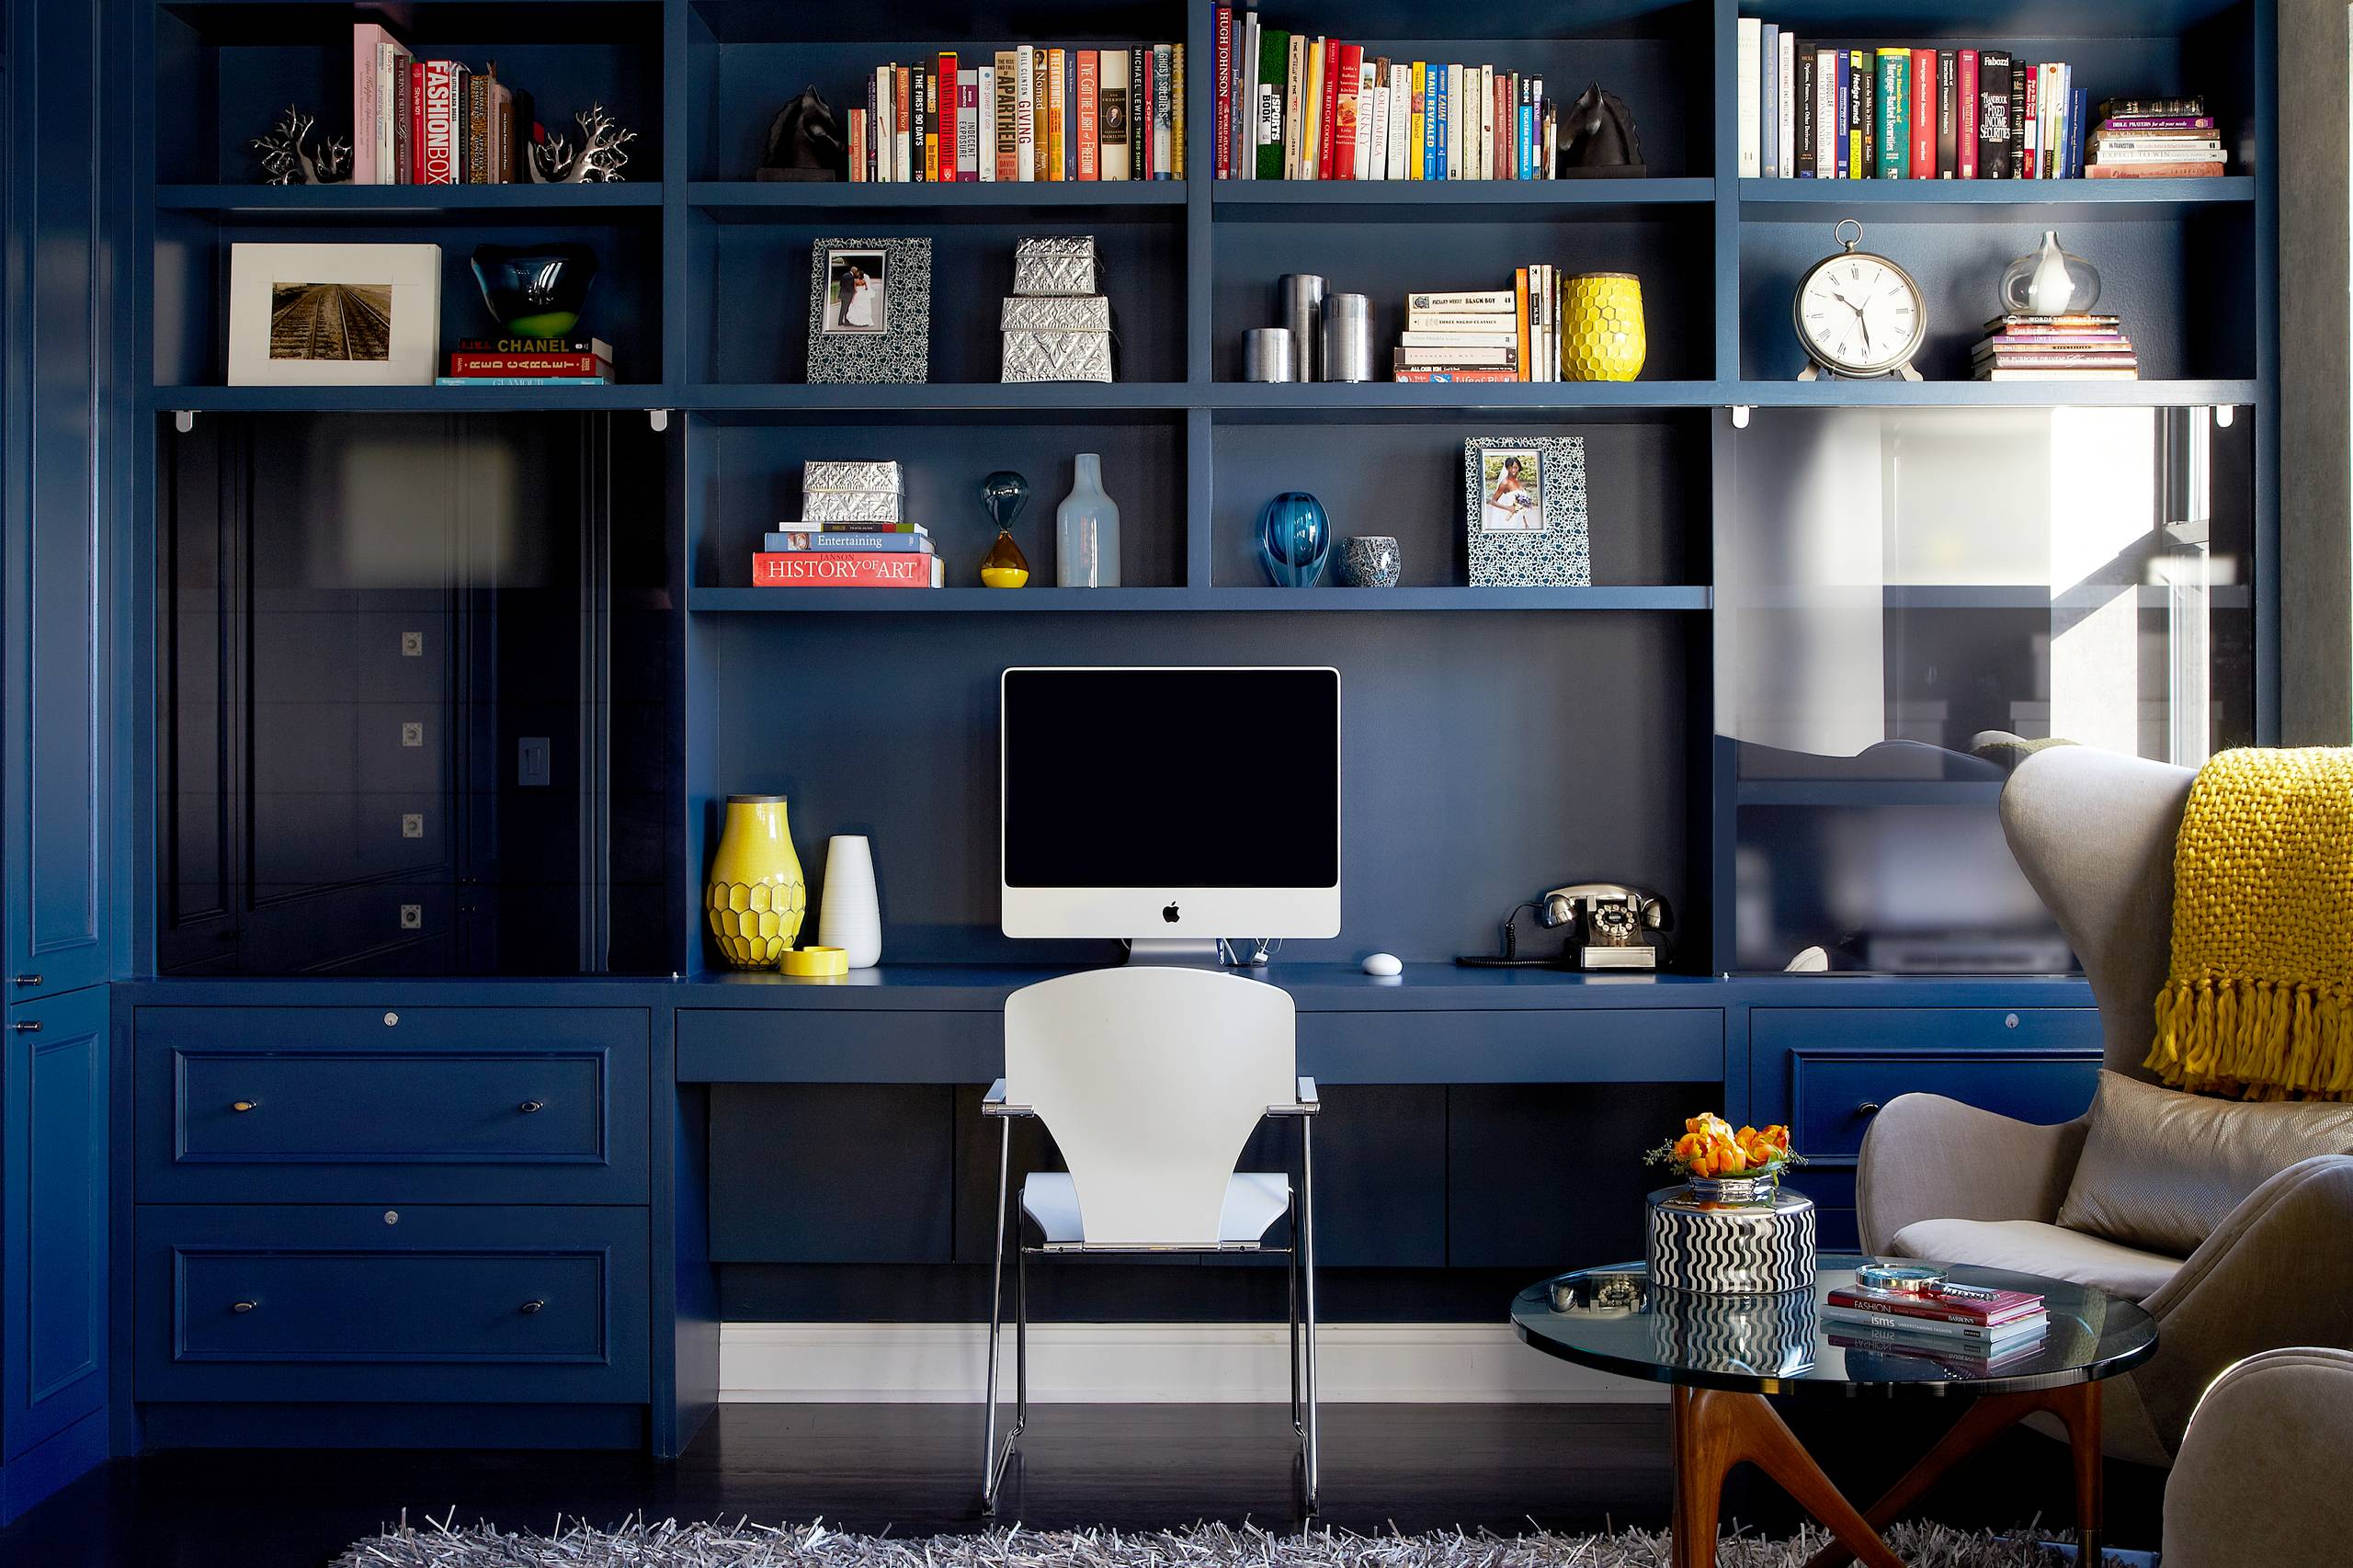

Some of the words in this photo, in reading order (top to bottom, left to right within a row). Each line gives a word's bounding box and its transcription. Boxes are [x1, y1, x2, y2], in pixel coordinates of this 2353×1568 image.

[1220, 11, 1229, 45] HUGH
[1081, 63, 1093, 76] I'VE
[1158, 52, 1168, 77] GHOST
[1219, 46, 1229, 97] JOHNSON
[1984, 56, 2009, 67] Fabozzi
[926, 74, 936, 113] BRAINWASHED
[1035, 71, 1046, 110] Nomad
[1050, 52, 1062, 108] FREAKONOMICS
[1081, 78, 1094, 96] GOT
[1427, 71, 1436, 97] MAUI
[1852, 73, 1860, 100] Hedge
[1884, 63, 1896, 119] Mortgage-Backed
[1081, 97, 1093, 109] THE
[1158, 81, 1168, 118] SOLDIERS
[1262, 95, 1271, 123] BOOK
[1376, 90, 1386, 122] SOUTH
[1818, 80, 1826, 116] OPTIONS
[1984, 94, 2008, 105] HANDBOOK
[1987, 104, 2006, 117] FIXED
[427, 61, 449, 185] FASHIONBOX
[915, 114, 923, 124] 90
[997, 76, 1016, 153] APARTHEID
[1018, 100, 1031, 144] GIVING
[1081, 111, 1095, 131] LIGHT
[1271, 98, 1280, 141] SPORTS
[1358, 93, 1373, 149] TURKEY
[1427, 99, 1435, 148] REVEALED
[1852, 100, 1860, 125] Funds
[1896, 115, 1903, 124] of
[1984, 114, 2007, 128] INCOME
[915, 126, 924, 146] DAYS
[959, 121, 967, 158] EXPOSURE
[1374, 124, 1383, 156] AFRICA
[1818, 117, 1826, 163] HANDBOOK
[1885, 119, 1895, 152] Securities
[1980, 124, 2011, 140] SECURITIES
[1081, 142, 1095, 174] FREEDOM
[1851, 138, 1860, 177] DUMMIES
[497, 339, 570, 353] CHANEL
[469, 360, 504, 369] RED
[506, 360, 575, 369] CARPET
[817, 535, 882, 548] Entertaining
[767, 561, 863, 578] HISTORY
[861, 560, 880, 570] OF
[875, 562, 917, 579] ART
[1854, 1300, 1892, 1313] FASHION
[1948, 1314, 1974, 1324] BARRON'S
[1897, 1323, 1933, 1332] UNDERSTANDING
